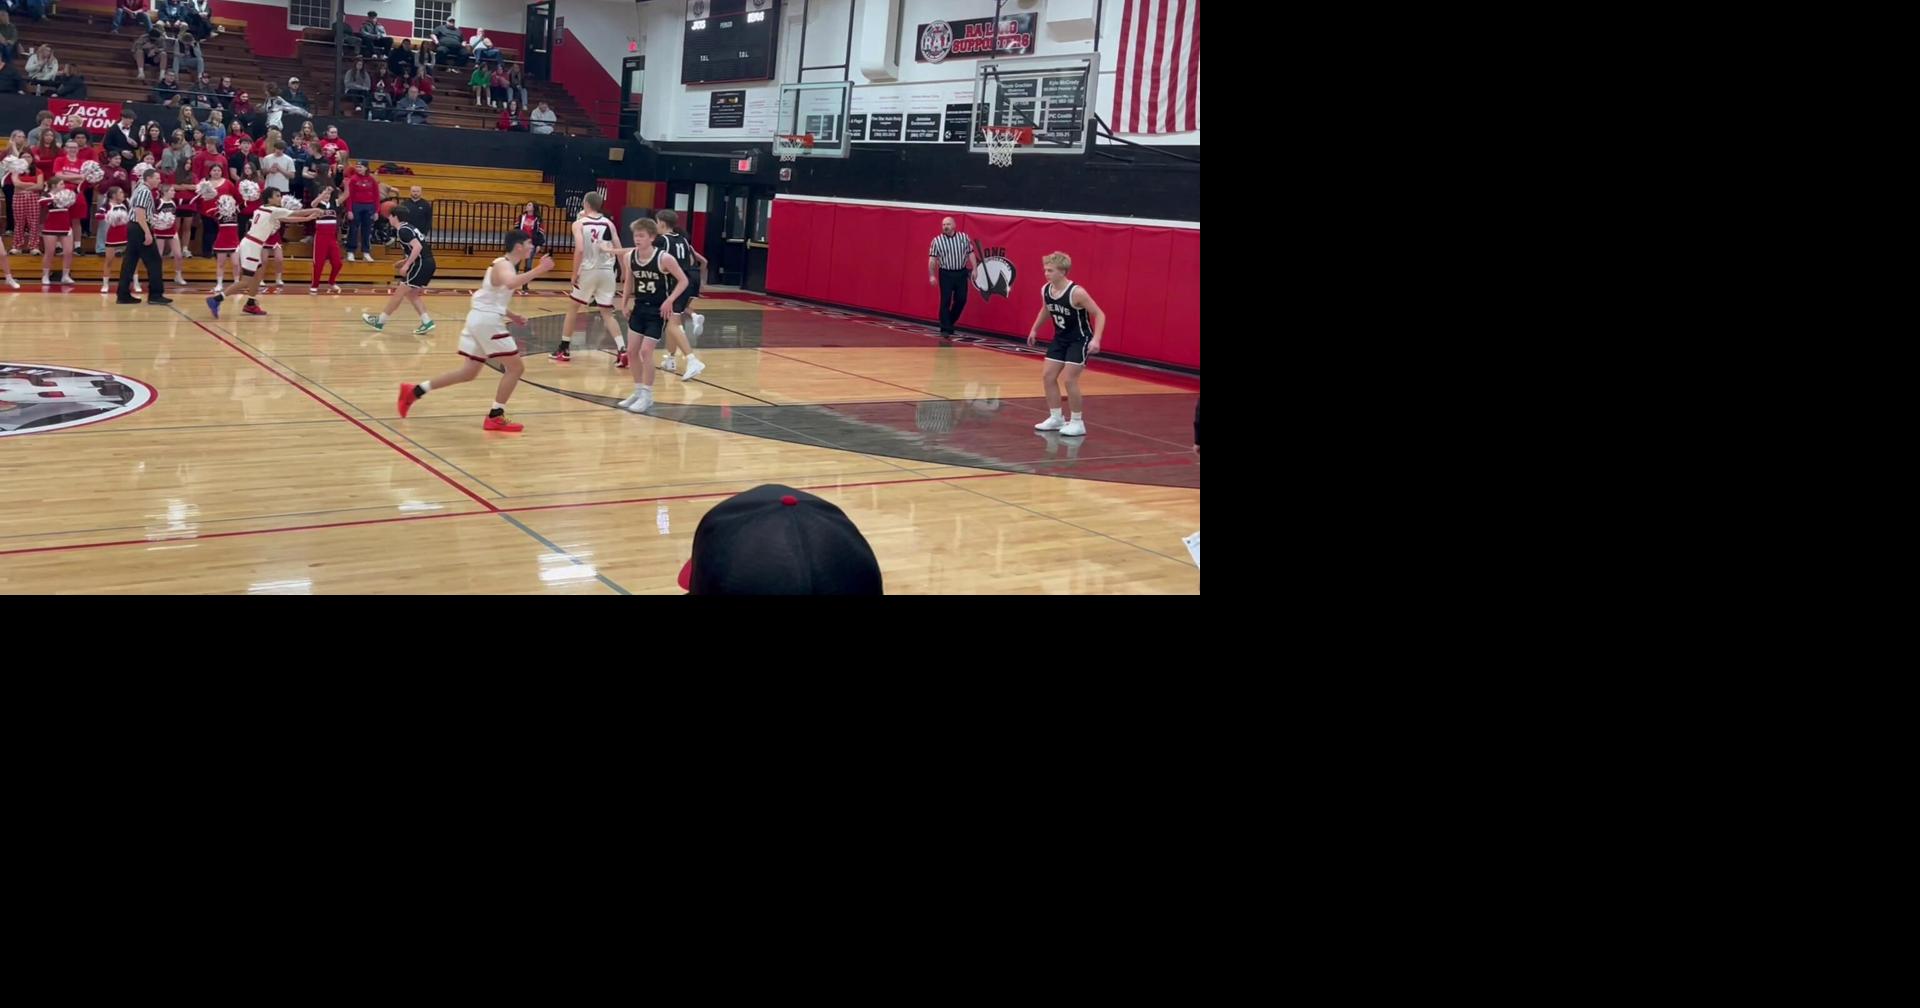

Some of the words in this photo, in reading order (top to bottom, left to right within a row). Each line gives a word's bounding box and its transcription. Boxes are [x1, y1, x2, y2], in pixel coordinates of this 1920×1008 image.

[951, 33, 1031, 54] SUPPOTERS
[62, 103, 110, 117] JACK
[53, 115, 117, 128] NTION
[675, 243, 685, 259] 11
[638, 280, 656, 294] 24
[1052, 314, 1066, 329] 12
